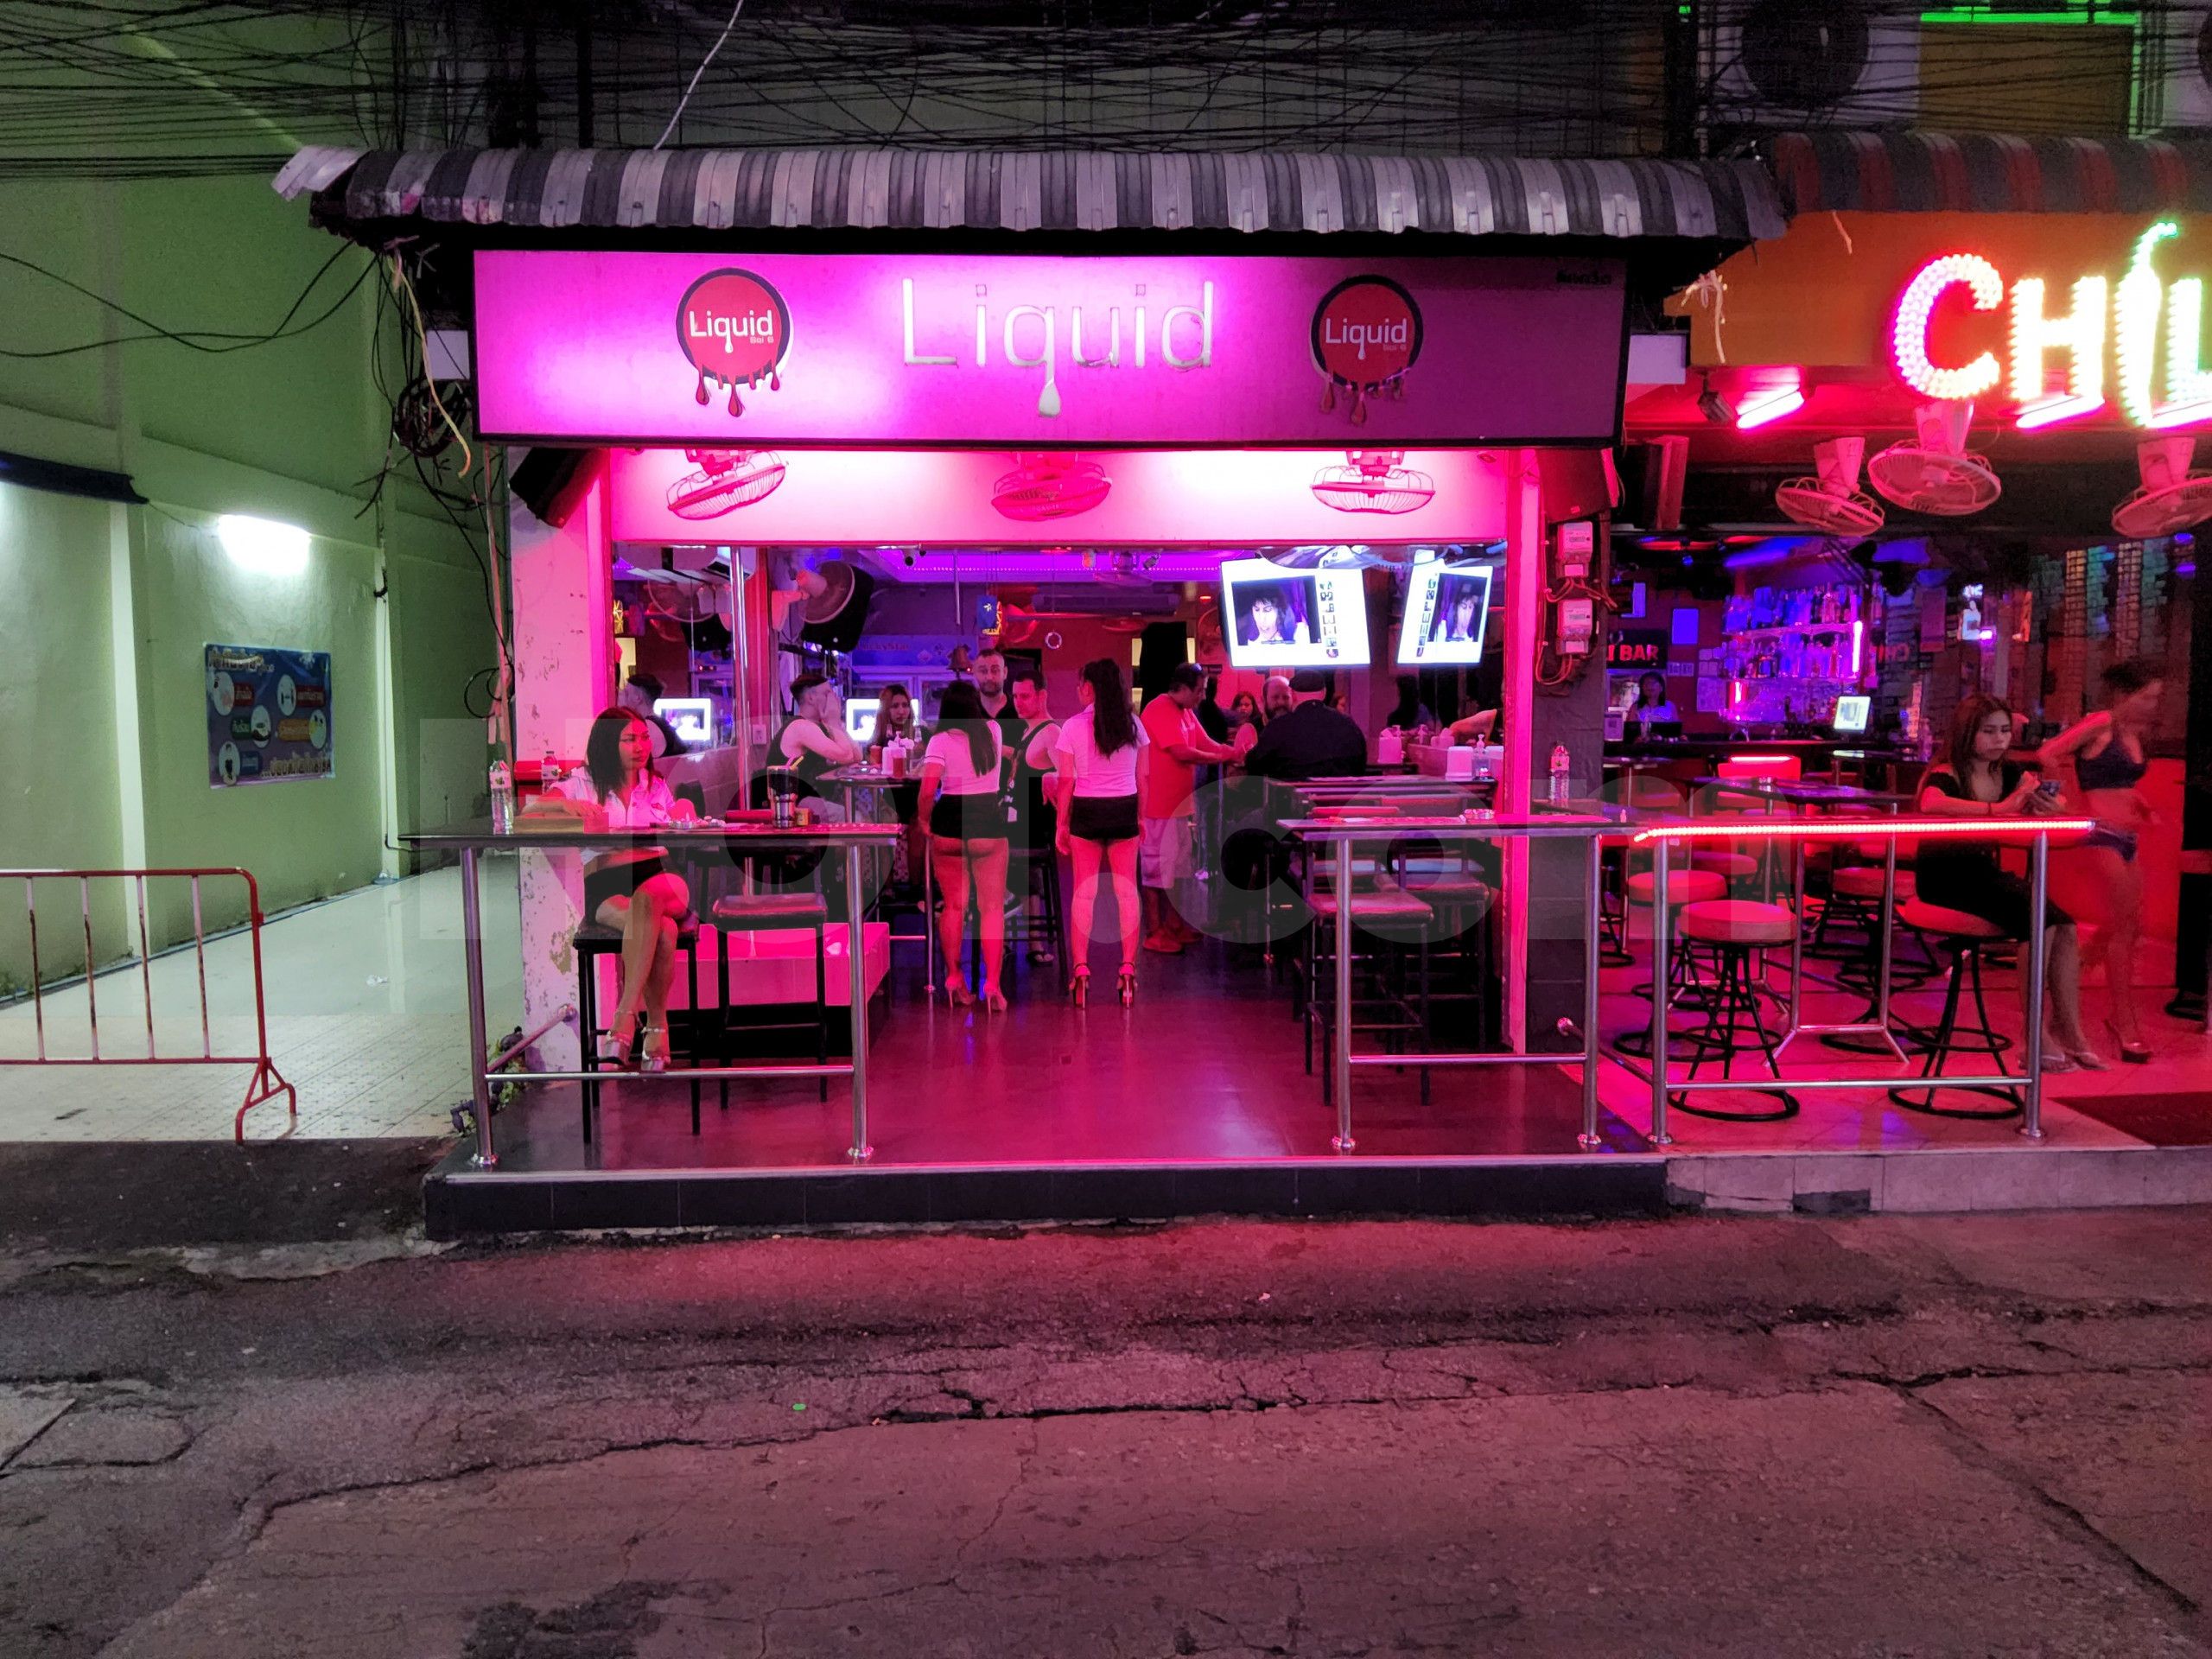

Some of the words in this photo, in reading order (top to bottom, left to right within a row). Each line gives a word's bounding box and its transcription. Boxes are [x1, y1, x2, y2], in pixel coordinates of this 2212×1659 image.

[689, 309, 773, 353] Liquid
[902, 278, 1214, 417] Liquid
[1325, 317, 1408, 360] Liquid
[1619, 644, 1659, 661] BAR
